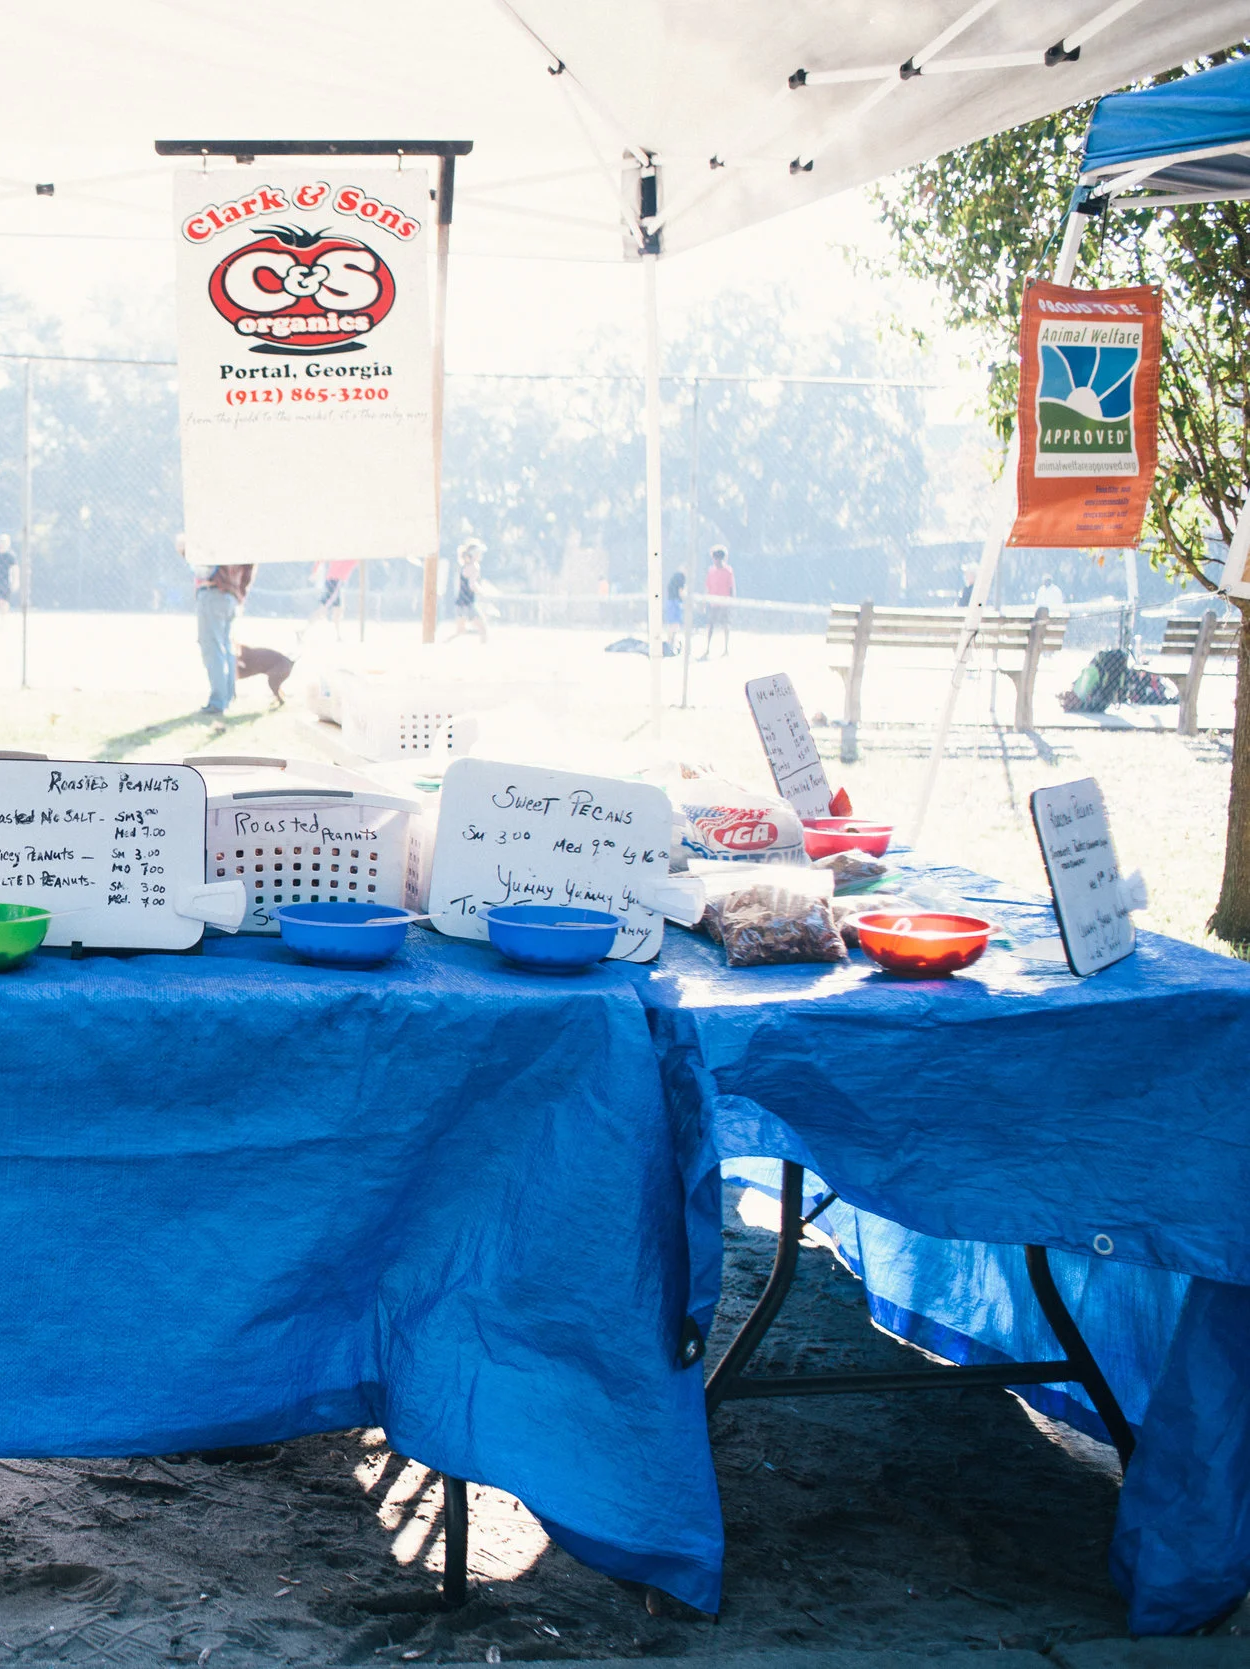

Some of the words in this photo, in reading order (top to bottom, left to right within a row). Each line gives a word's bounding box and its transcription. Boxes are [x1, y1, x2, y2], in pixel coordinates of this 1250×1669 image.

[184, 188, 288, 242] Clark
[295, 183, 328, 208] &
[335, 188, 419, 239] Sons
[221, 247, 383, 313] C&S
[1038, 298, 1093, 314] PROUD
[1093, 303, 1119, 315] TO
[1120, 303, 1143, 316] BE
[236, 312, 373, 338] organics
[1041, 326, 1088, 343] Animal
[1091, 328, 1140, 345] Welfare
[220, 364, 297, 380] Portal,
[306, 362, 393, 380] Georgia
[226, 388, 283, 405] (912)
[291, 387, 389, 401] 865-3200
[1043, 429, 1125, 445] APPROVED
[235, 812, 320, 836] Roasted
[322, 827, 378, 844] Peanuts
[722, 823, 769, 845] IGA
[553, 838, 582, 853] Med
[623, 846, 636, 865] Lg
[450, 895, 477, 915] To
